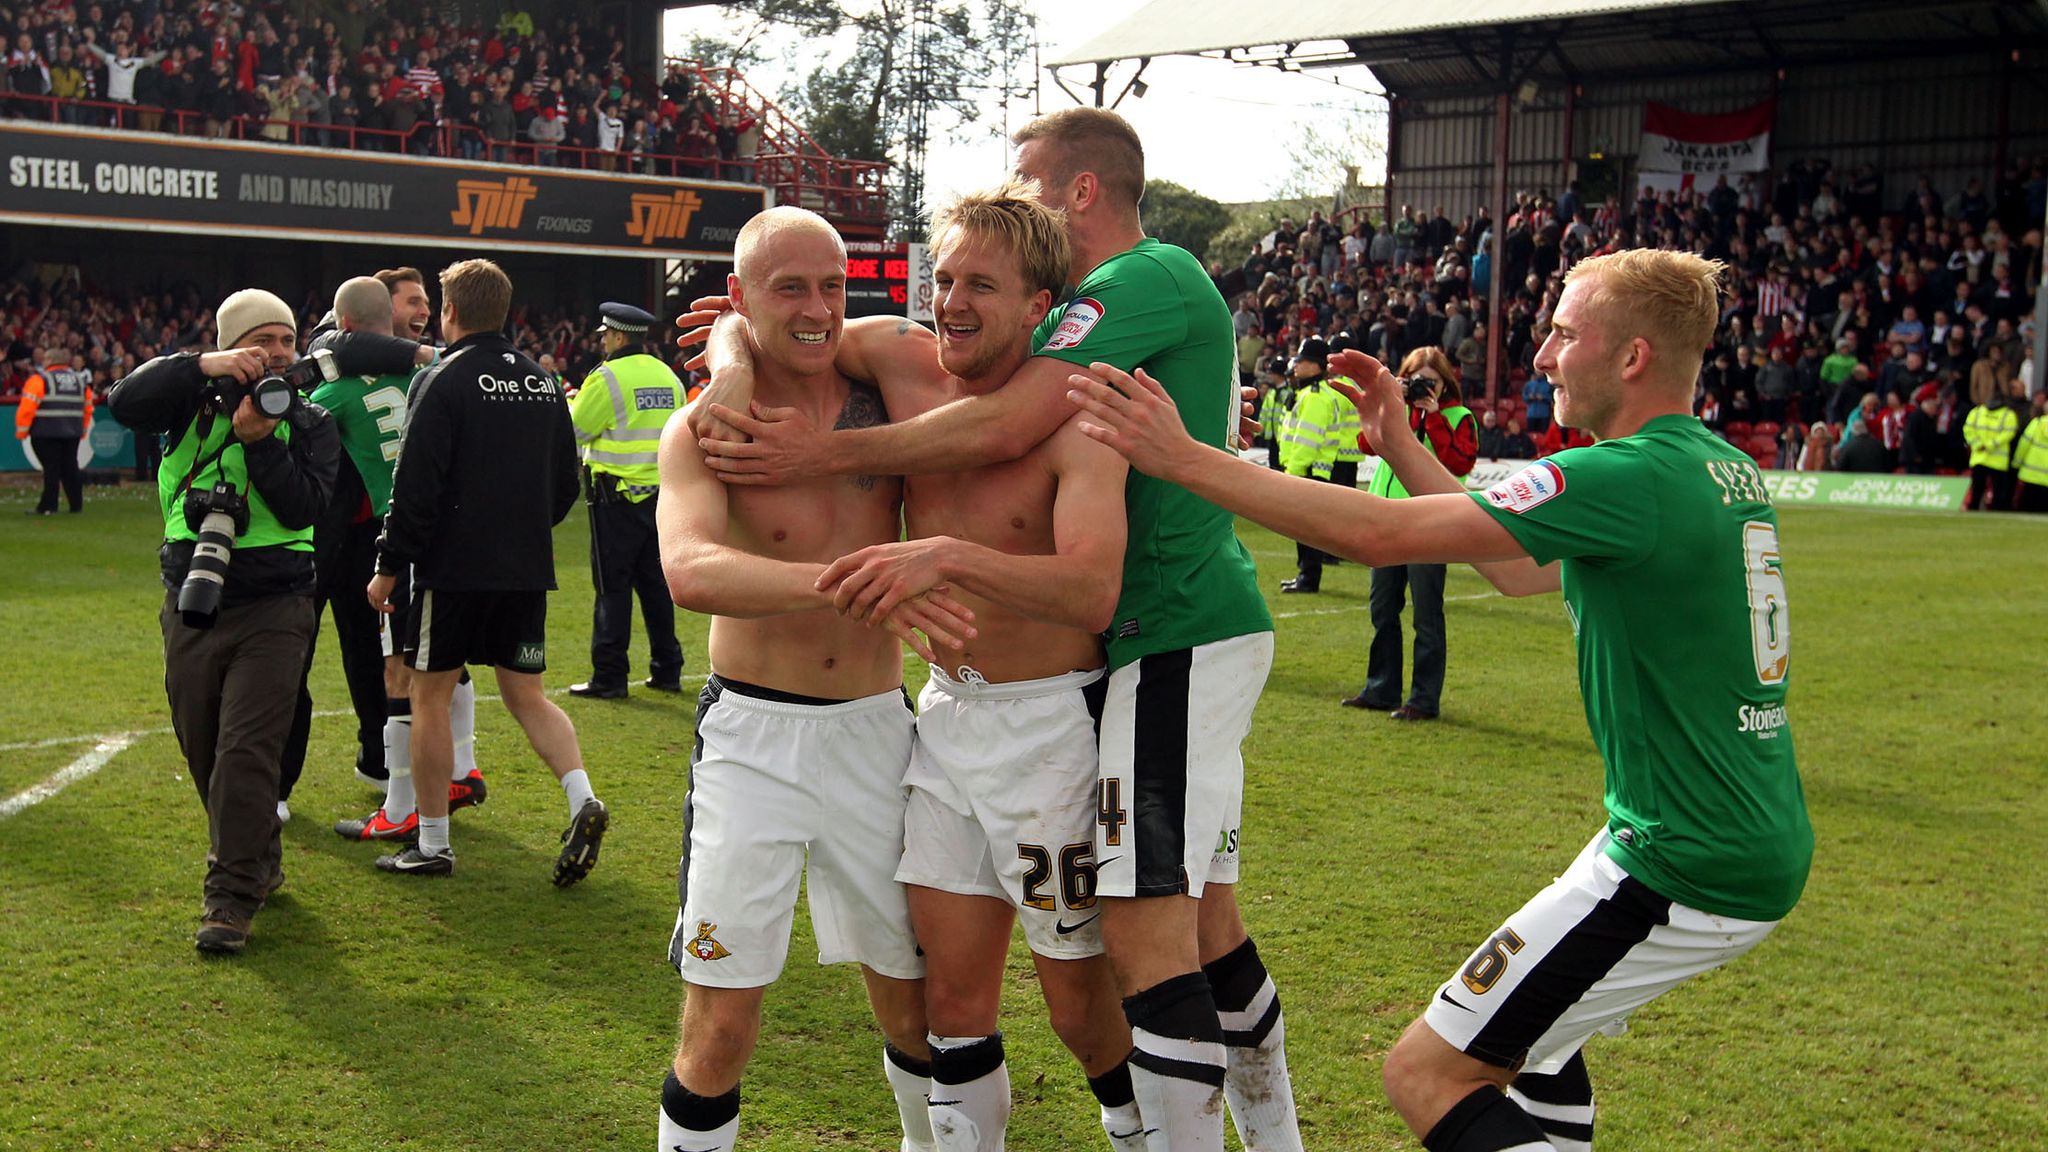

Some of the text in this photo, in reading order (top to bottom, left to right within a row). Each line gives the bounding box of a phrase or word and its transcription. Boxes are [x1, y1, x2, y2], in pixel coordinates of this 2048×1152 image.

[1663, 139, 1753, 159] JAKARTA
[9, 155, 393, 211] STEEL, CONCRETE AND MASONRY
[536, 215, 592, 234] FIXINGS
[883, 242, 897, 252] FC
[478, 374, 556, 395] One Call
[483, 395, 557, 403] INSURANCE
[636, 395, 674, 409] POLICE
[362, 386, 407, 462] 3
[1849, 478, 1942, 494] JOIN NOW
[1742, 520, 1790, 685] 6
[1098, 778, 1127, 846] 4
[1017, 841, 1098, 911] 26
[1461, 927, 1525, 995] 6
